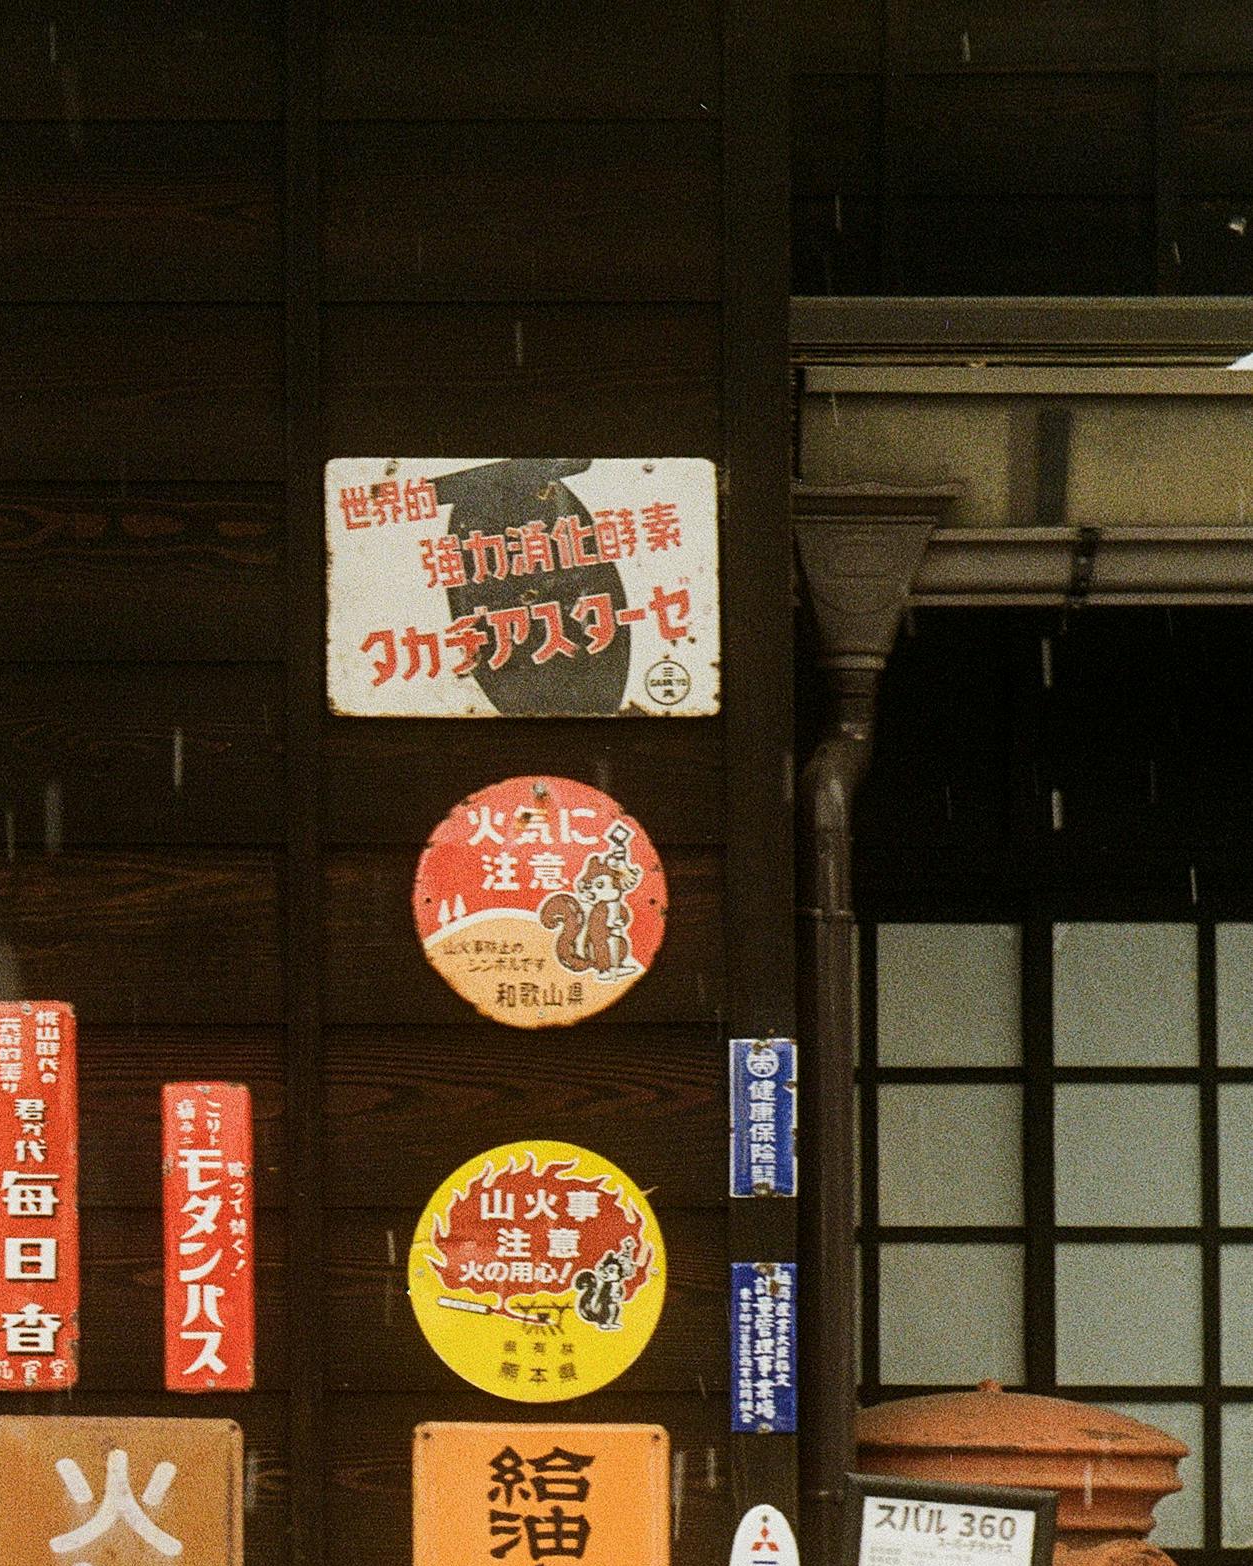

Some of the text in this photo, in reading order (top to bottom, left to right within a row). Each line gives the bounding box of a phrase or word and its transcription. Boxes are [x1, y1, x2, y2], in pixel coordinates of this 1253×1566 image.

[339, 476, 439, 530] 世界的
[418, 502, 682, 589] 強力消化酵素
[466, 805, 599, 846] 火気に
[481, 850, 570, 891] 注意
[497, 981, 585, 1008] 和歌山県
[479, 1188, 602, 1222] 山火事
[0, 1170, 62, 1354] 毎日香
[177, 1148, 228, 1376] モダンパス
[496, 1226, 582, 1259] 注意
[874, 1503, 1017, 1542] スバル 360
